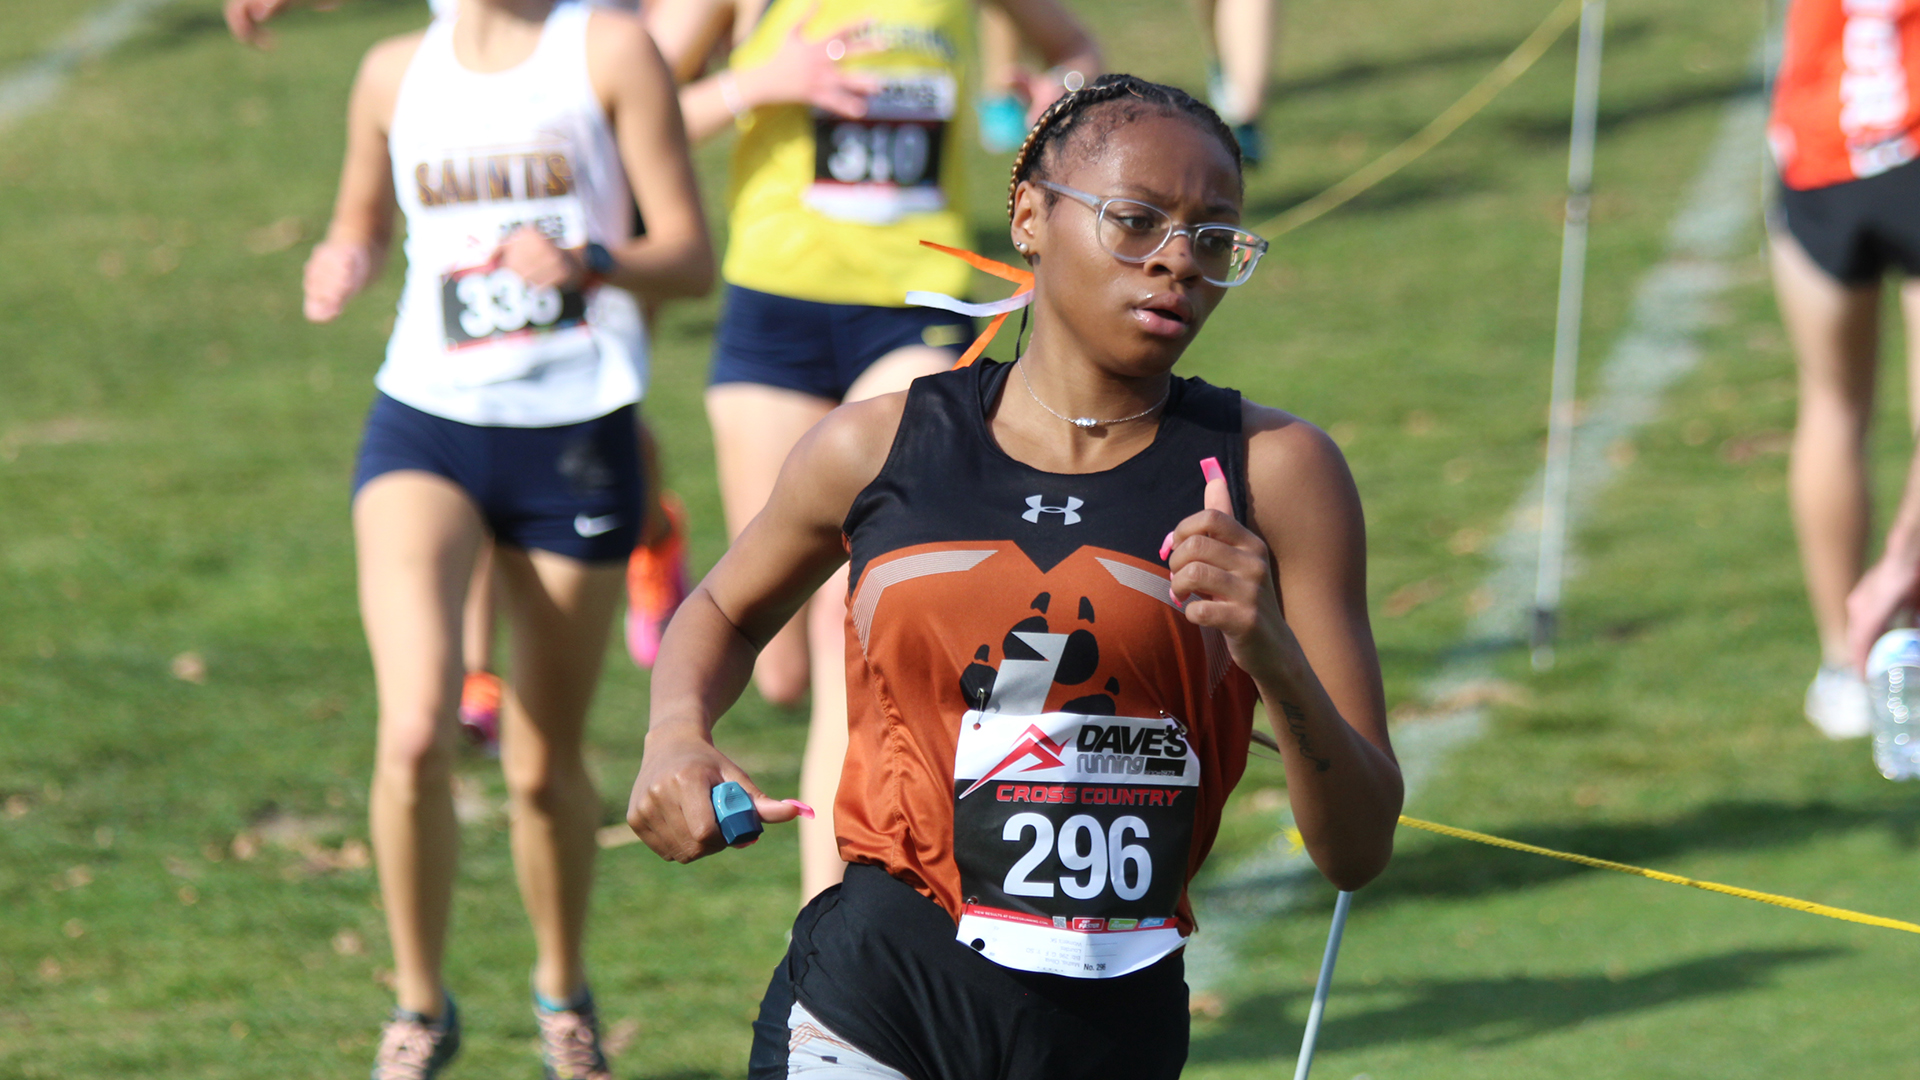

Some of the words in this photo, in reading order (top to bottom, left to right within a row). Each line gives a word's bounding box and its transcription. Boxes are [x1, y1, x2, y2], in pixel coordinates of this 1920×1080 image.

[827, 122, 929, 185] 310
[414, 153, 573, 208] SAINTS
[1077, 725, 1187, 758] DAVE'S
[1077, 753, 1145, 775] running
[996, 784, 1077, 804] CROSS
[1081, 787, 1181, 806] COUNTRY
[1002, 812, 1152, 901] 296
